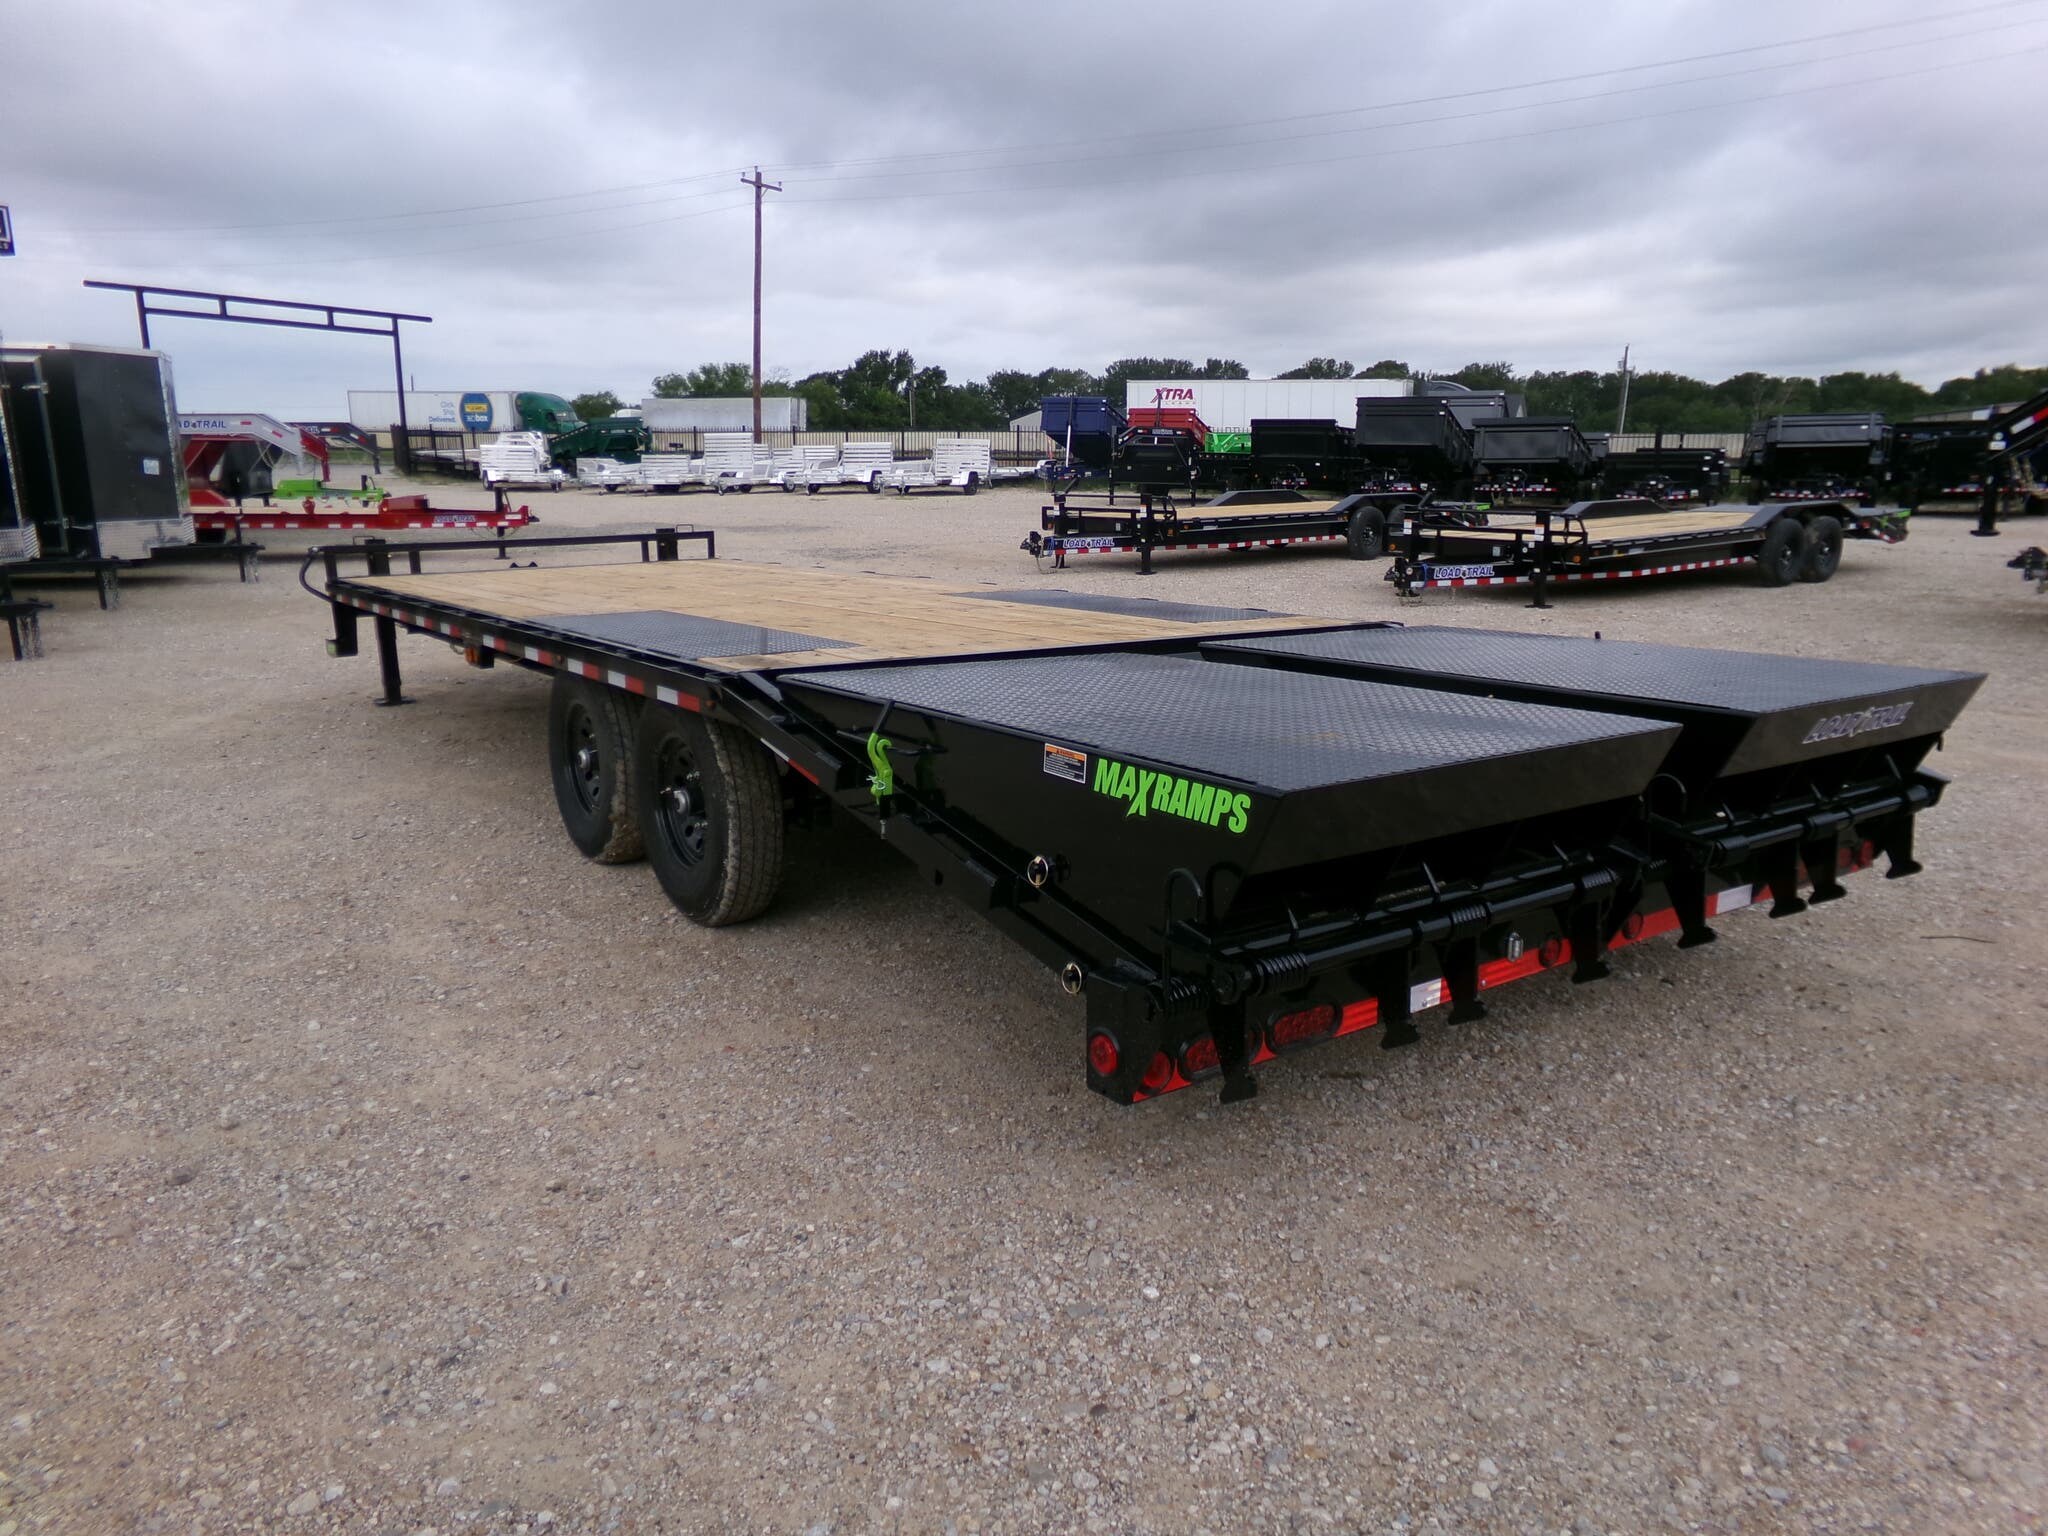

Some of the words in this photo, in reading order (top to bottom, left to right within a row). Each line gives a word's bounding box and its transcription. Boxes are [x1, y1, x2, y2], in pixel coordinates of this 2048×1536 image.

[1150, 387, 1194, 403] XTRA
[196, 420, 226, 429] TRAIL
[1063, 538, 1087, 548] LOAD
[1090, 537, 1115, 547] TRAIL
[1434, 566, 1461, 579] LOAD
[1466, 564, 1495, 577] TRAIL
[1093, 757, 1251, 834] MAXRAMPS
